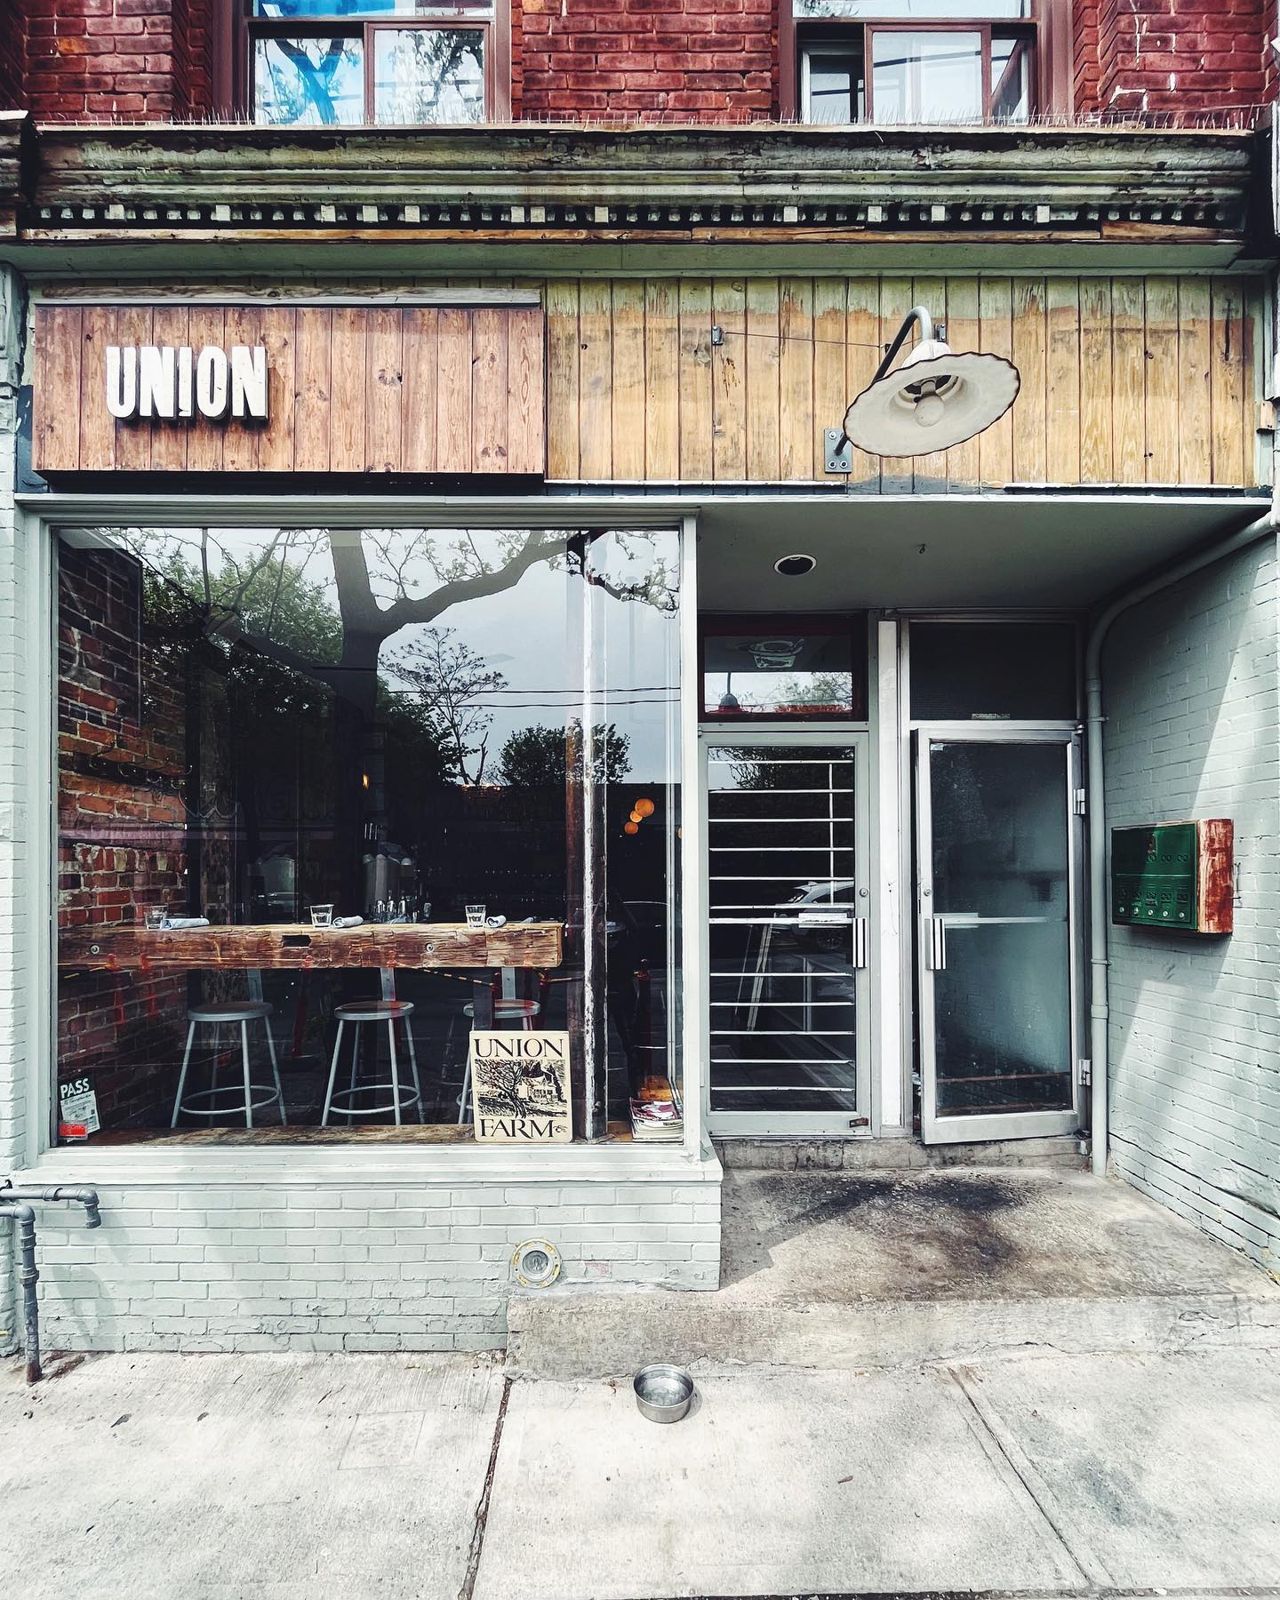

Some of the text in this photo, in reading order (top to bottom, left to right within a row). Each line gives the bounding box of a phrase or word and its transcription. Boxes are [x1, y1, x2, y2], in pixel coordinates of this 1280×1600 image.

[106, 346, 269, 420] UNION
[473, 1038, 563, 1057] UNION
[60, 1078, 90, 1098] PASS
[480, 1119, 554, 1139] FARM
